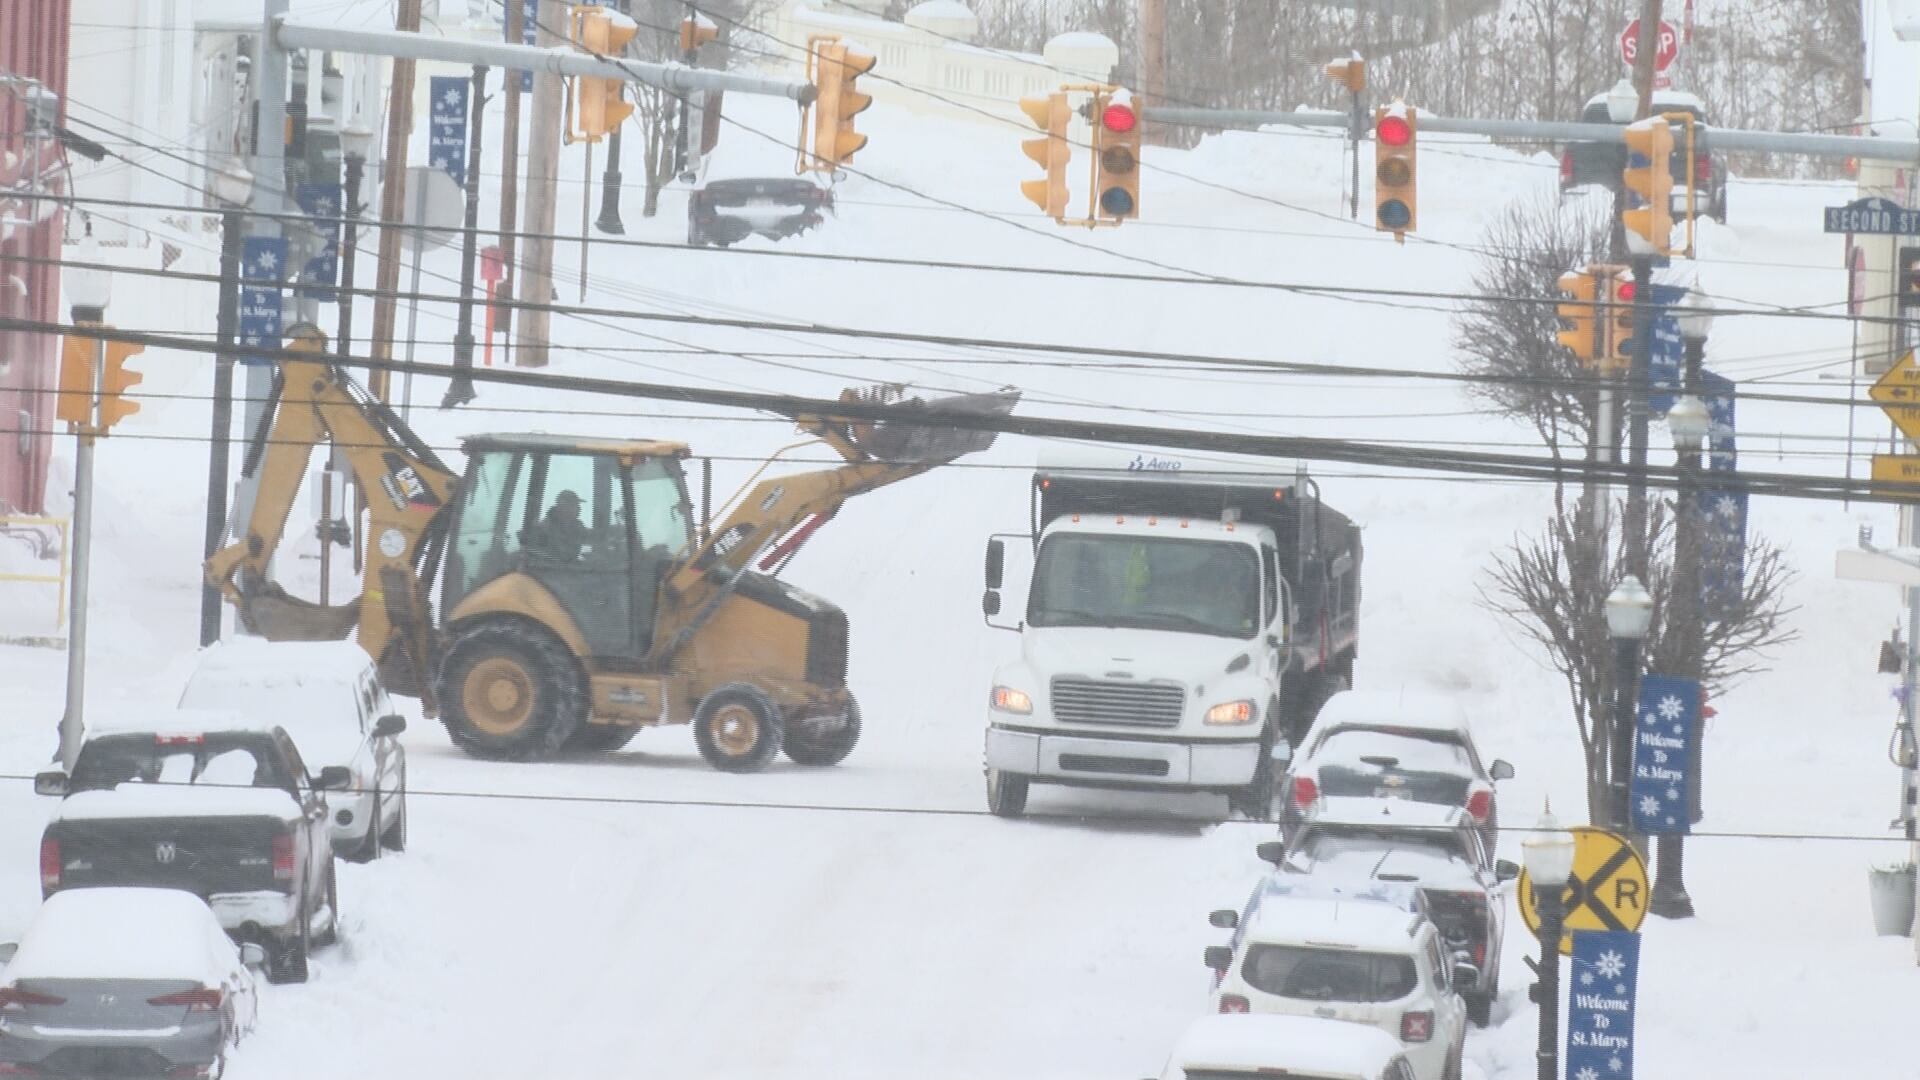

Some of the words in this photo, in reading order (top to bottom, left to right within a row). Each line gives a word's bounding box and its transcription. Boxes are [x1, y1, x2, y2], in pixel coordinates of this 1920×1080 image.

[1625, 32, 1674, 58] SP
[1831, 209, 1891, 232] SECOND
[1900, 211, 1919, 233] ST
[1147, 456, 1182, 471] Aero
[1641, 732, 1684, 749] Welcome
[1654, 750, 1668, 763] To
[1636, 765, 1650, 778] St.
[1651, 765, 1683, 784] Marys
[1616, 879, 1640, 909] R
[1576, 993, 1629, 1011] Welcome
[1593, 1014, 1610, 1029] To
[1572, 1031, 1588, 1046] St.
[1590, 1031, 1629, 1054] Marys
